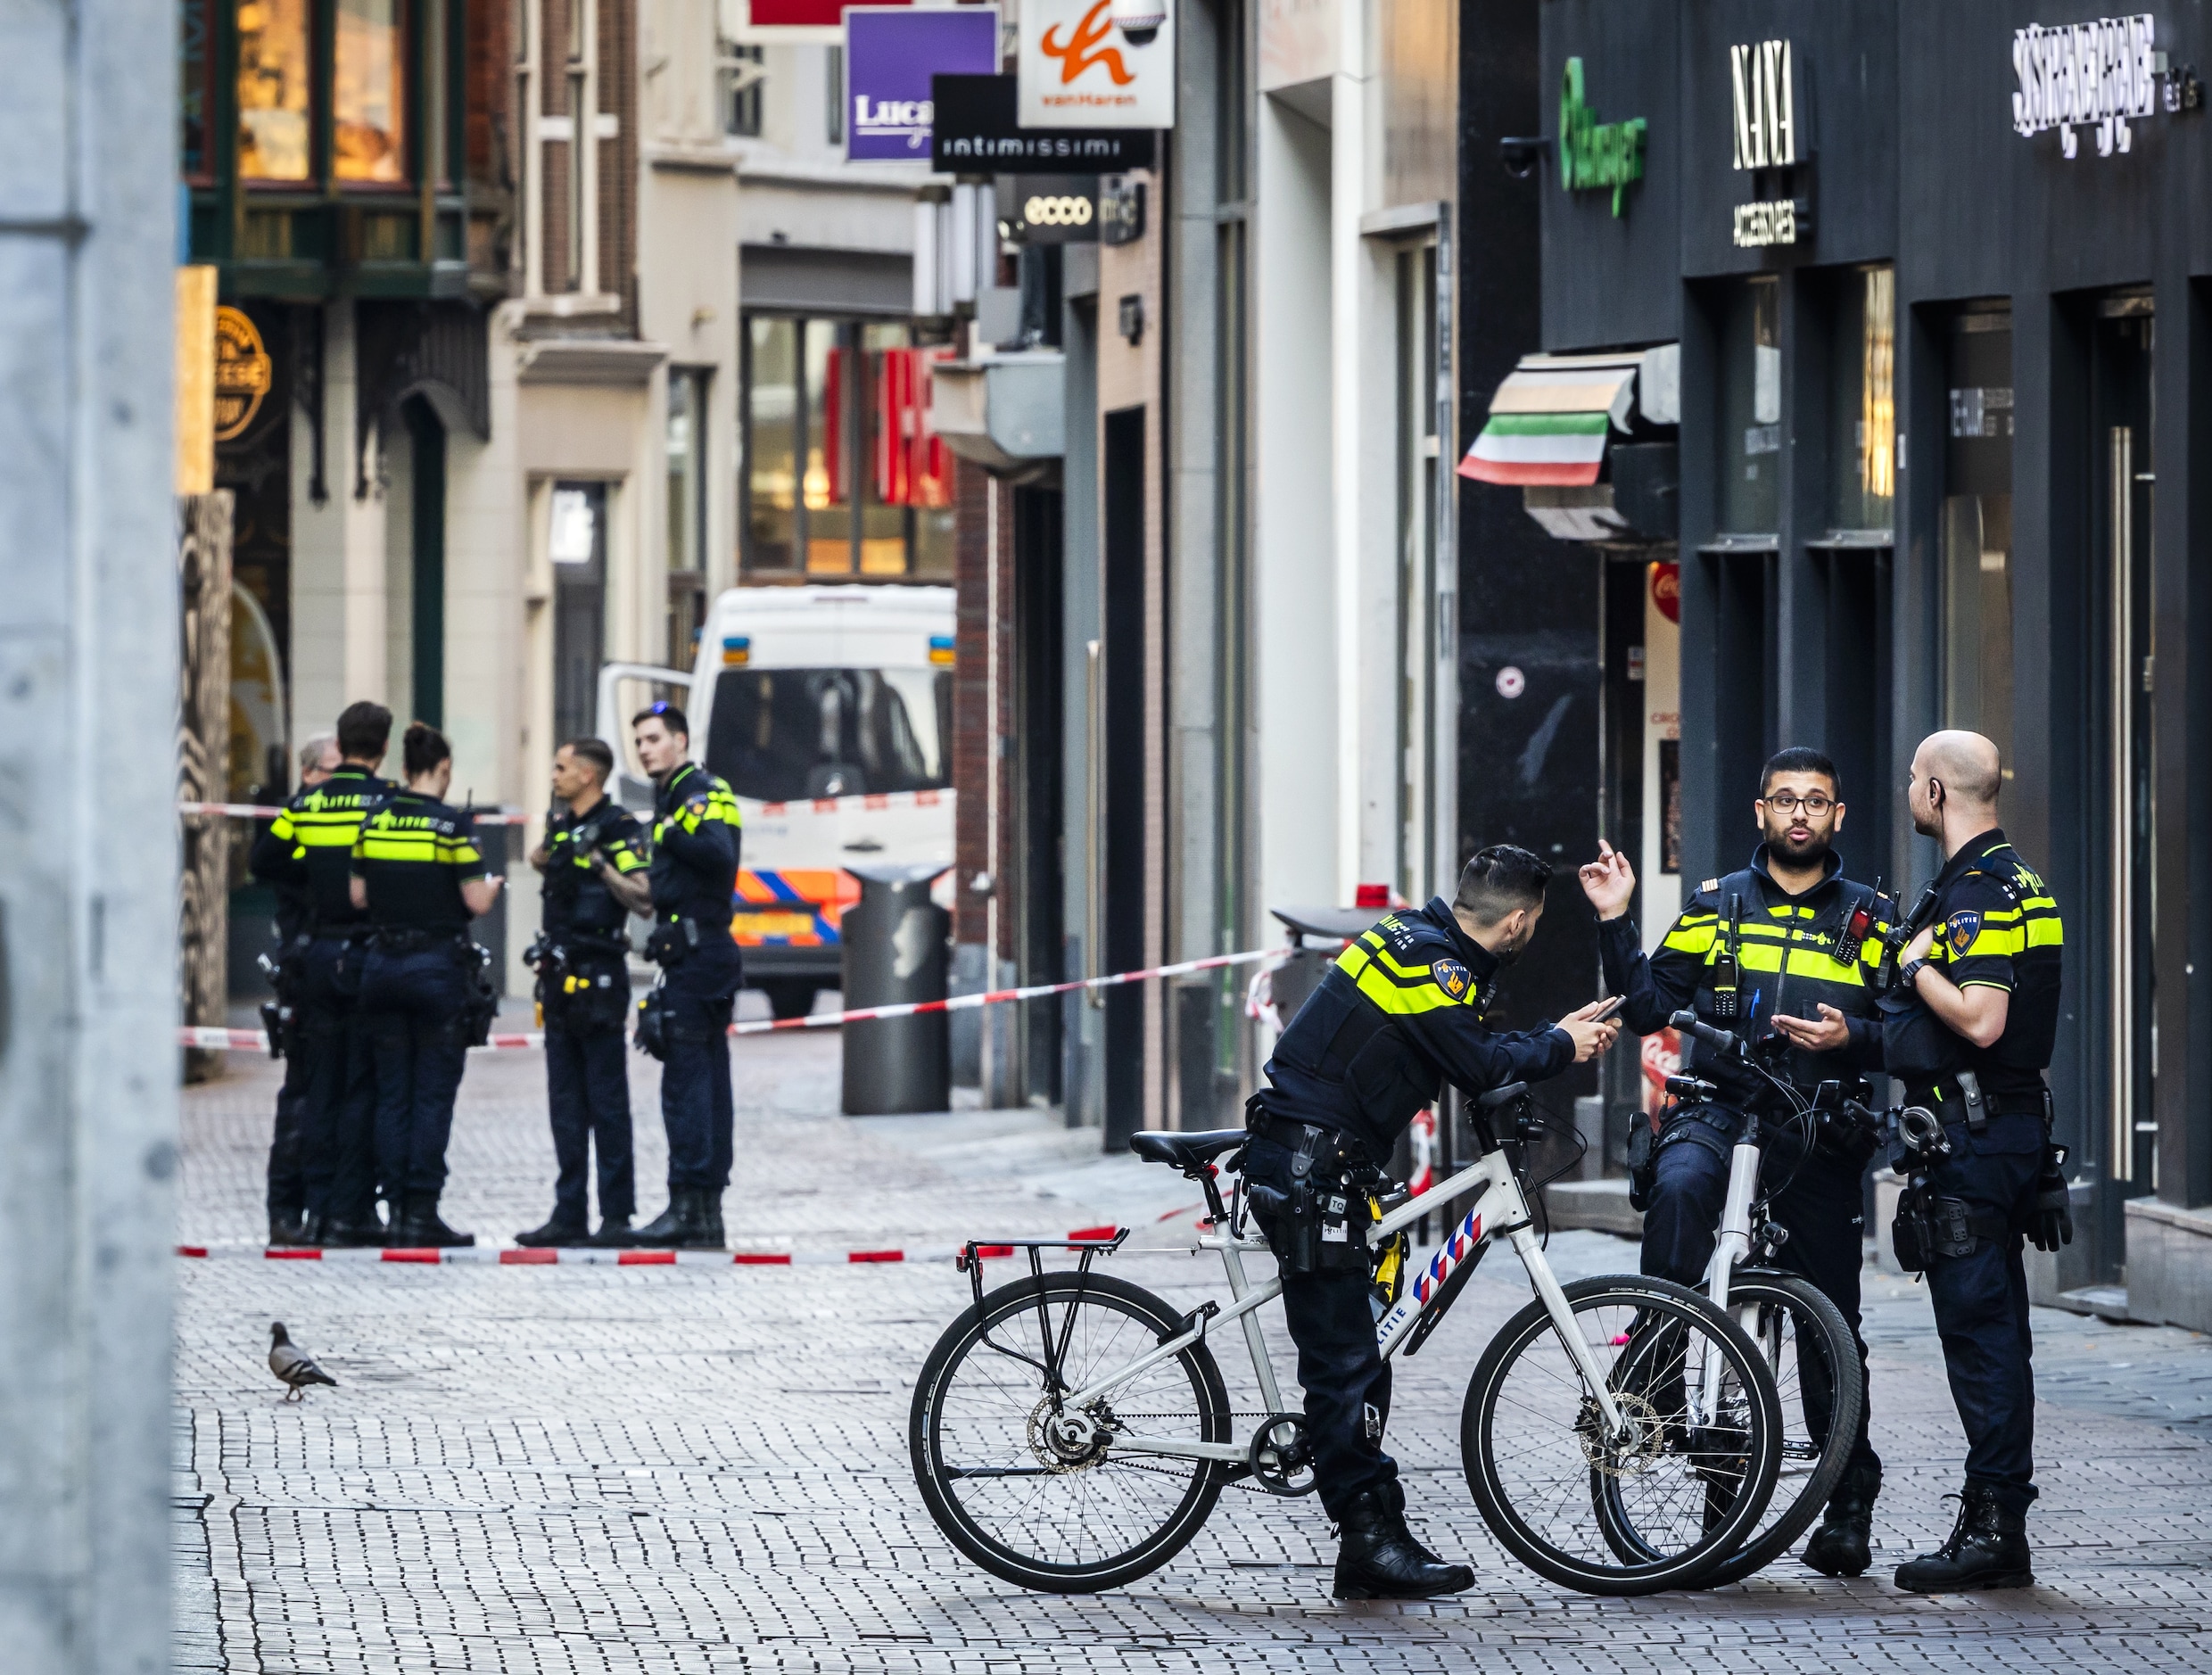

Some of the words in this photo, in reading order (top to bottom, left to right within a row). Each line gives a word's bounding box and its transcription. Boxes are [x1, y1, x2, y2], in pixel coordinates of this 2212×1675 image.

[854, 95, 934, 126] Luca
[1730, 38, 1795, 169] NANA
[943, 136, 1121, 157] intimissimi
[1025, 195, 1093, 225] ecco
[1437, 962, 1467, 972] POLITIE
[1333, 1200, 1343, 1211] TQ
[1377, 1307, 1407, 1345] LITIE
